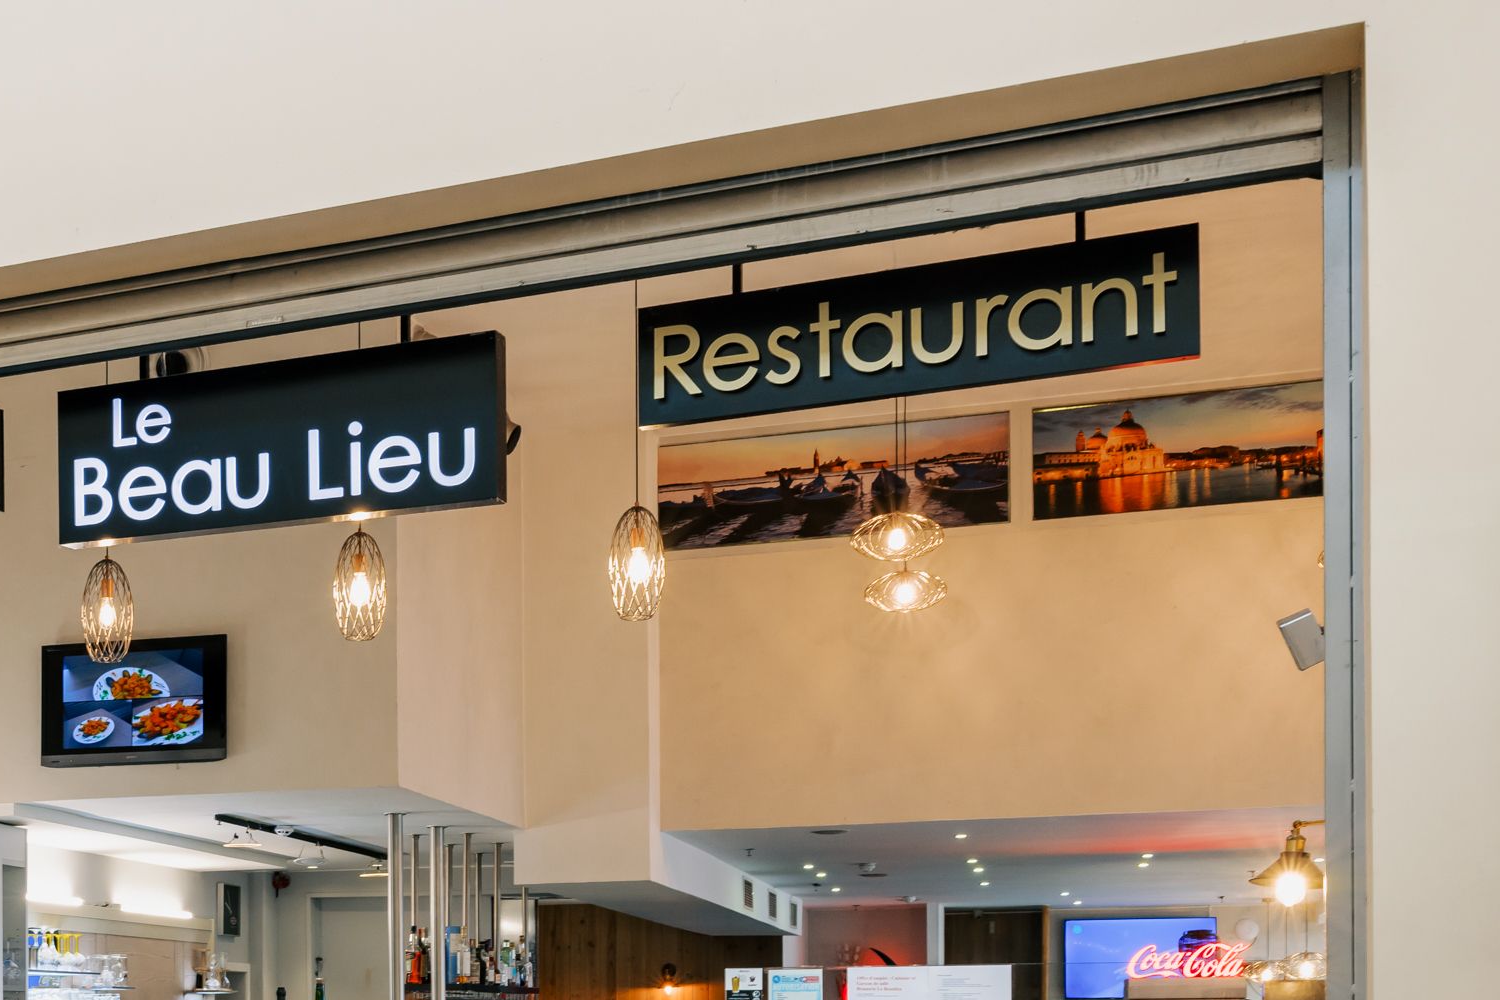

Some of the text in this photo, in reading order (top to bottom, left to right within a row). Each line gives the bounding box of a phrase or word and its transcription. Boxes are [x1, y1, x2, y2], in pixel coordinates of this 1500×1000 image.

[653, 251, 1178, 400] Restaurant
[112, 398, 172, 448] Le
[73, 419, 478, 528] Beau Lieu
[1126, 942, 1252, 979] Coca-Cola
